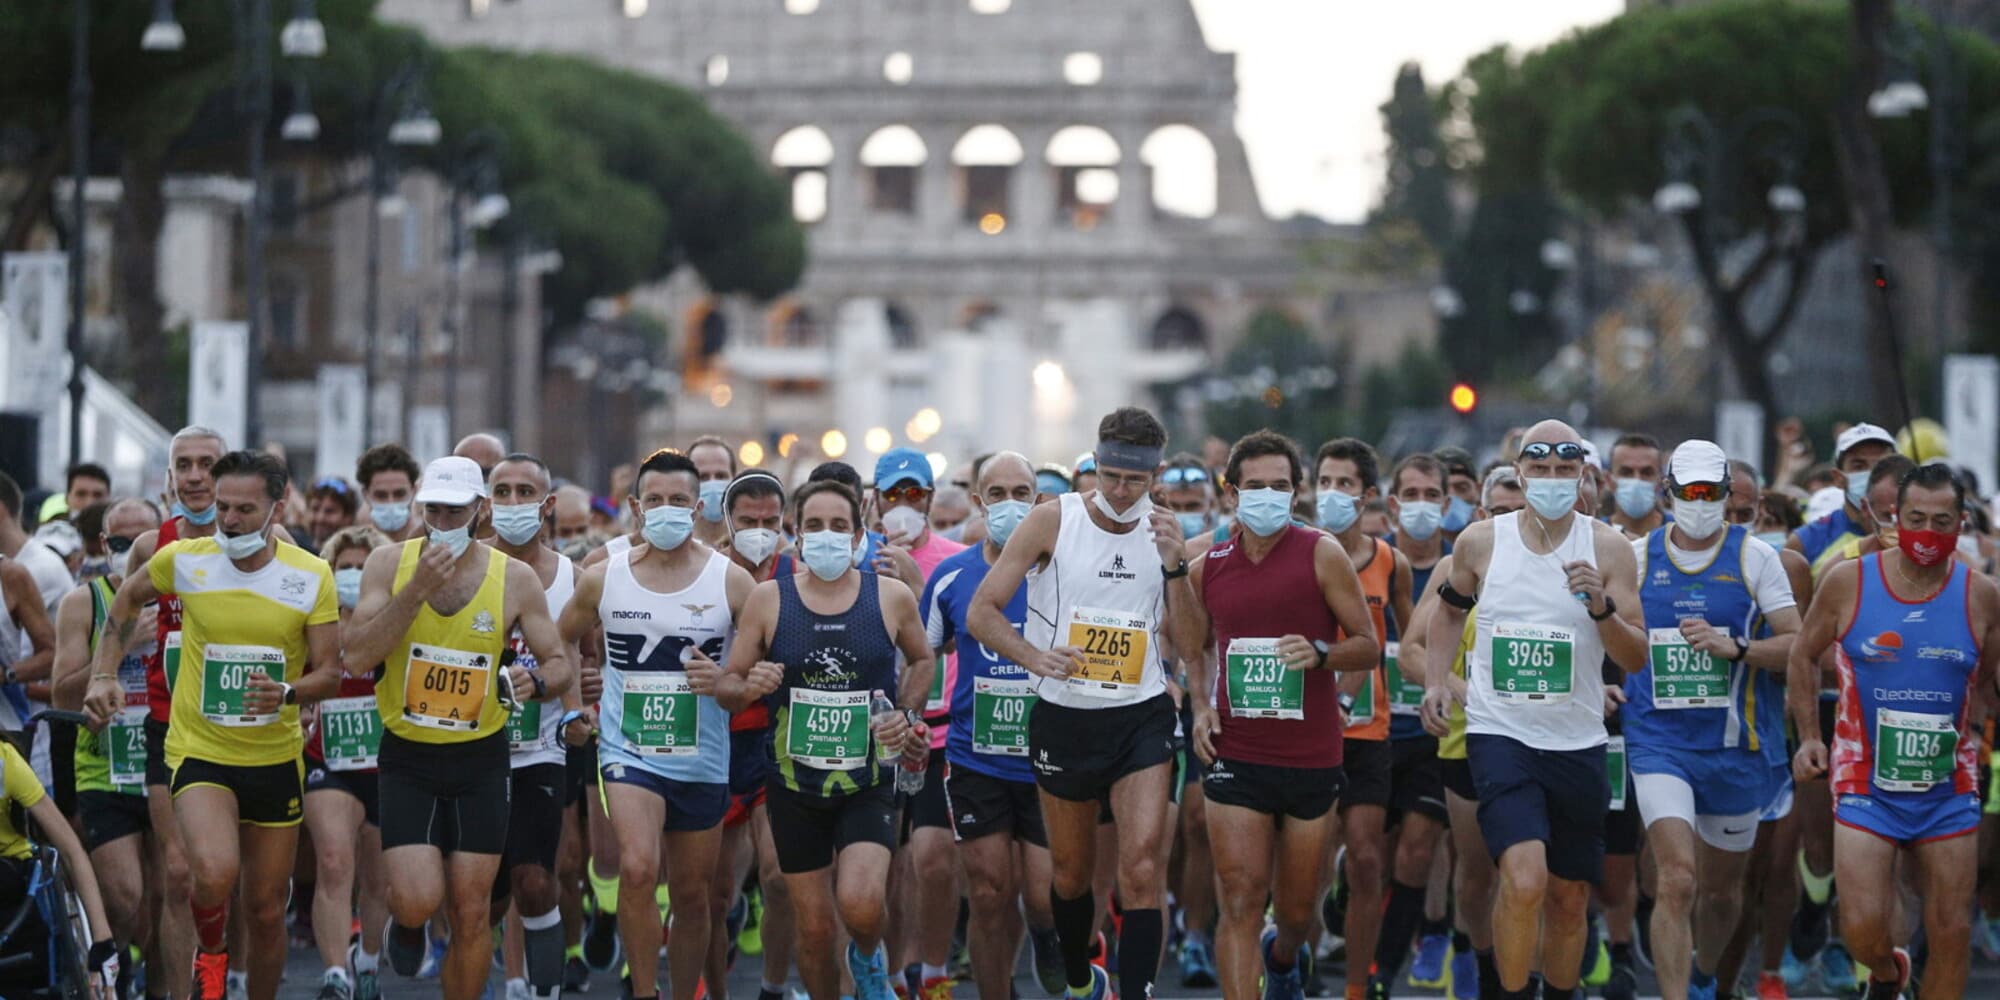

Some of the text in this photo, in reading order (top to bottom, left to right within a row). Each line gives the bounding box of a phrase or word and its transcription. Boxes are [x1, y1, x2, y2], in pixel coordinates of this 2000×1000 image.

[1115, 572, 1136, 580] SPORT
[612, 610, 651, 620] macron
[1093, 616, 1146, 628] acea 2021
[1514, 629, 1570, 640] acea 2021
[1085, 628, 1132, 658] 2265
[261, 653, 282, 661] 2021
[433, 654, 462, 665] acea
[804, 647, 858, 664] ATLETICA
[1507, 641, 1555, 667] 3965
[1666, 647, 1713, 672] 5936
[1089, 657, 1115, 666] DANIELE
[1081, 666, 1122, 682] 4 A
[1243, 657, 1287, 683] 2337
[423, 665, 472, 696] 6015
[642, 682, 692, 692] acea 202
[1507, 678, 1549, 692] 6 B
[992, 686, 1020, 695] acea
[1667, 684, 1708, 697] 9 B
[813, 695, 867, 704] acea 2021
[1242, 694, 1281, 708] 4 B
[218, 701, 227, 714] 9
[419, 702, 460, 720] 9 A
[642, 696, 676, 721] 652
[992, 698, 1025, 723] 409
[327, 711, 373, 738] F1131
[806, 707, 852, 733] 4599
[512, 729, 522, 740] B
[636, 732, 676, 745] 1 B
[808, 734, 843, 743] CRISTIANO
[988, 732, 1025, 745] 1 B
[806, 743, 846, 757] 7 B
[1895, 731, 1941, 758] 1036
[128, 761, 136, 773] 4
[1890, 768, 1933, 781] 2 B
